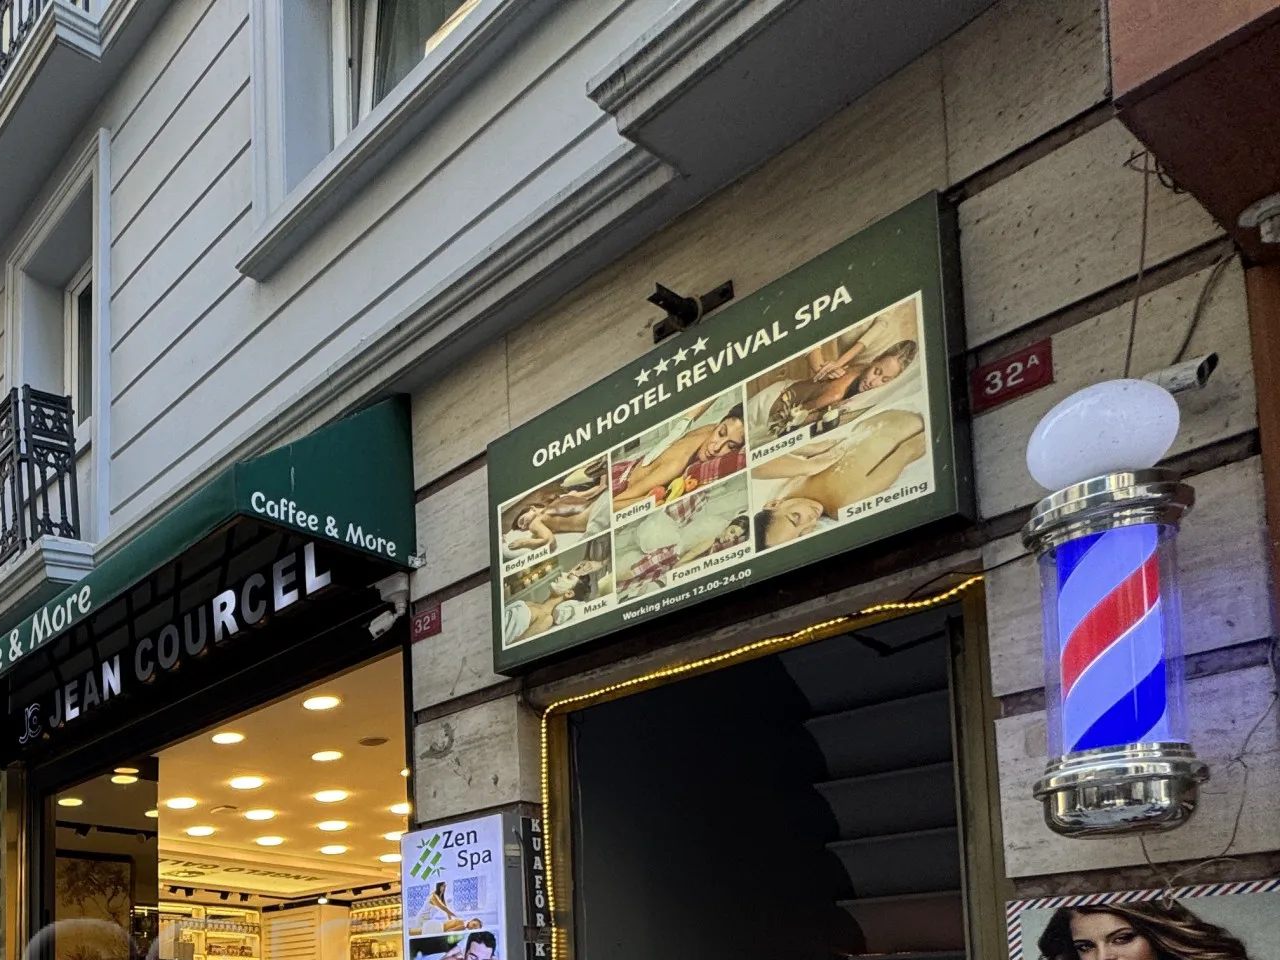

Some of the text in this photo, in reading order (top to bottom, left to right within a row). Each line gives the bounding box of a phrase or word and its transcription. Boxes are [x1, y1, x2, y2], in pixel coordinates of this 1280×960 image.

[531, 285, 853, 469] ORAN HOTEL REVİVAL SPA
[984, 354, 1041, 396] 32A
[751, 431, 805, 462] Massage
[615, 501, 651, 523] Peeling
[845, 480, 930, 519] Salt Peeling
[250, 491, 397, 557] Caffee & More
[504, 547, 548, 574] Body Mask
[672, 545, 752, 581] Foam Massage
[583, 599, 608, 615] Mask
[622, 568, 752, 622] Working Hours 12.00-24.00
[8, 630, 23, 659] &
[28, 583, 92, 652] More
[48, 543, 333, 728] JEAN COURCEL
[442, 829, 478, 851] Zen
[457, 847, 493, 871] Spa
[530, 817, 546, 929] KUAFÖR
